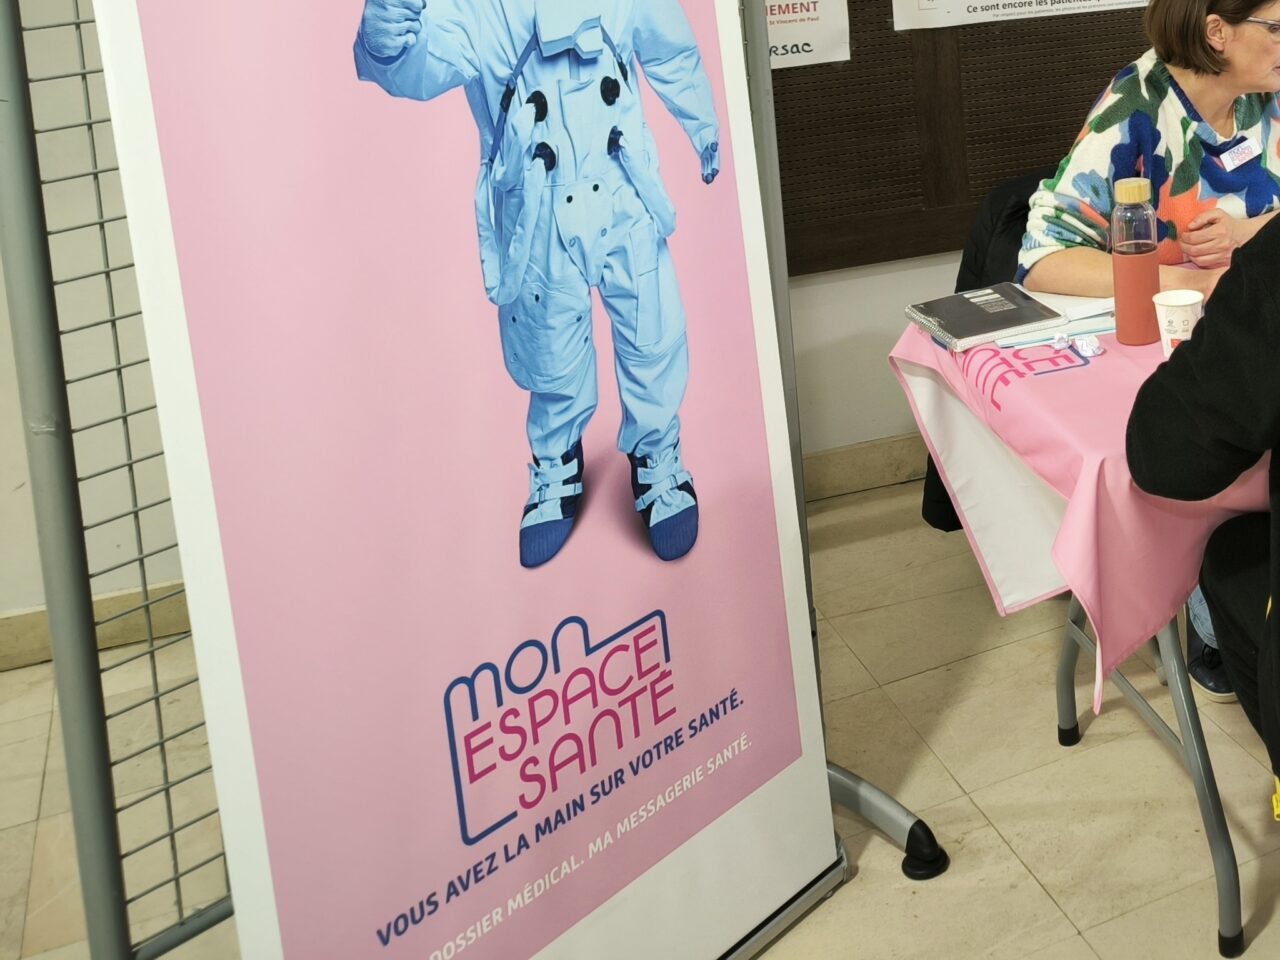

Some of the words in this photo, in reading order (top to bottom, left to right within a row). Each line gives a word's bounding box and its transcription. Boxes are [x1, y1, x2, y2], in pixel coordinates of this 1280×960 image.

[966, 4, 980, 14] Ce
[981, 3, 998, 13] sont
[1001, 0, 1032, 12] encore
[462, 624, 662, 785] ESPACE
[517, 669, 678, 810] SANTÉ
[375, 893, 440, 948] VOUS
[445, 854, 500, 905] AVEZ
[504, 833, 530, 863] LA
[534, 793, 587, 844] MAIN
[590, 768, 626, 805] SUR
[628, 728, 686, 777] VOTRE
[687, 688, 745, 735] SANTÉ.
[428, 906, 504, 960] DOSSIER
[506, 858, 586, 917] MÉDICAL.
[587, 833, 615, 861] MA
[615, 765, 705, 841] MESSAGERIE
[706, 731, 753, 776] SANTÉ.
